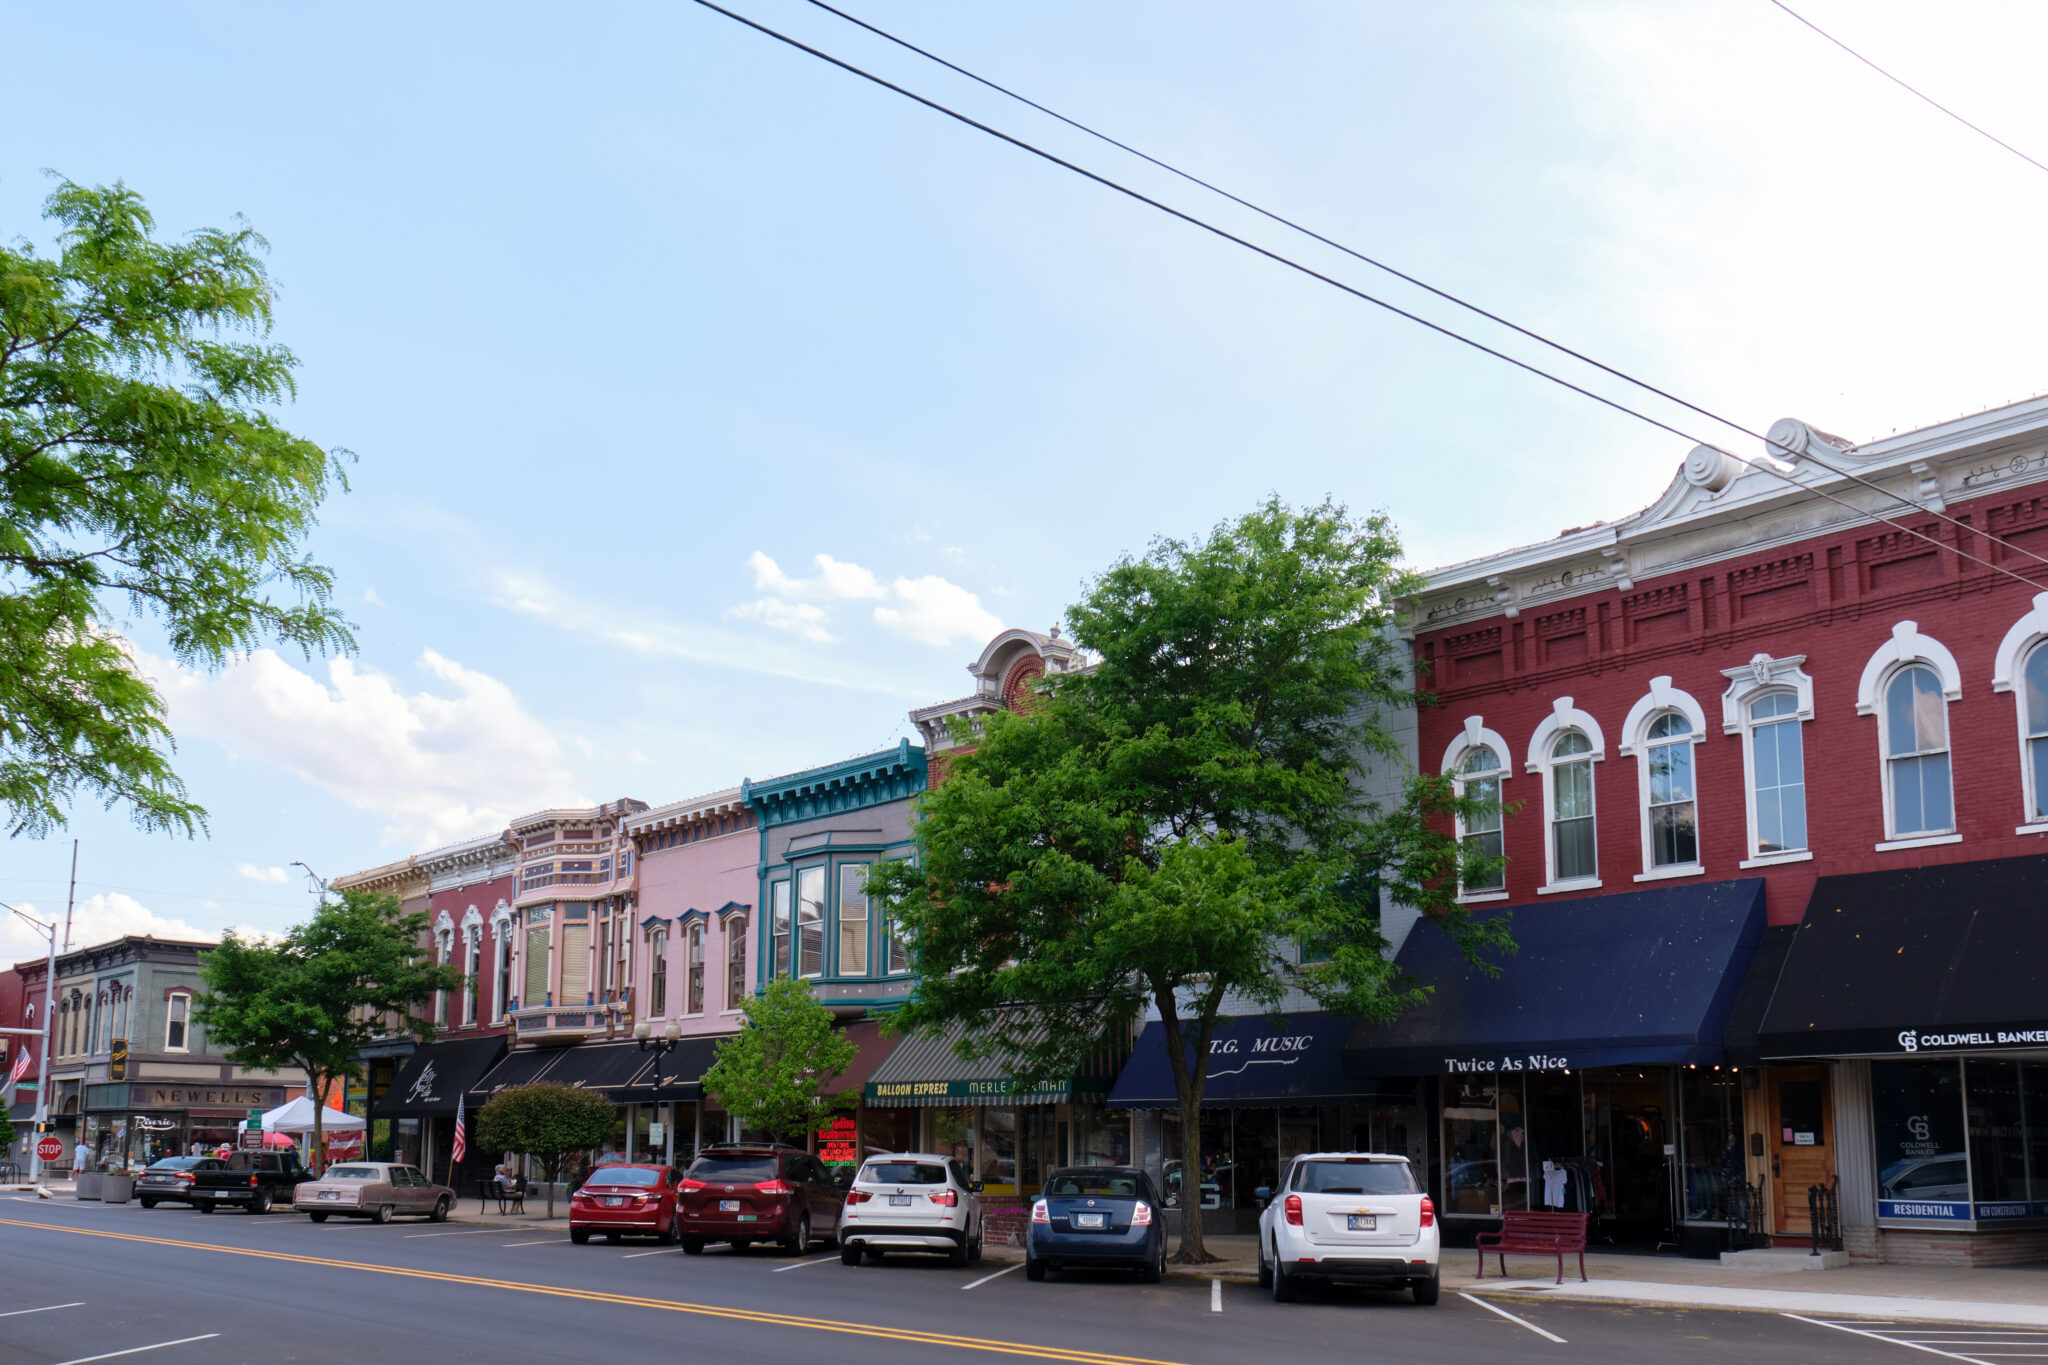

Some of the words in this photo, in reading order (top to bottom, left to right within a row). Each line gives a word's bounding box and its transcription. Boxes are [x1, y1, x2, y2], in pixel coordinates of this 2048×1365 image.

[1251, 1035, 1313, 1053] MUSIC
[1921, 1033, 1995, 1046] COLDWELL
[1444, 1058, 1496, 1073] Twice
[1500, 1056, 1523, 1071] As
[1528, 1055, 1568, 1070] Nice
[876, 1083, 911, 1096] BALLOON
[913, 1082, 949, 1095] EXPRESS
[969, 1082, 1007, 1094] MERLE
[38, 1144, 62, 1154] STOP
[1893, 1204, 1955, 1217] RESIDENTIAL
